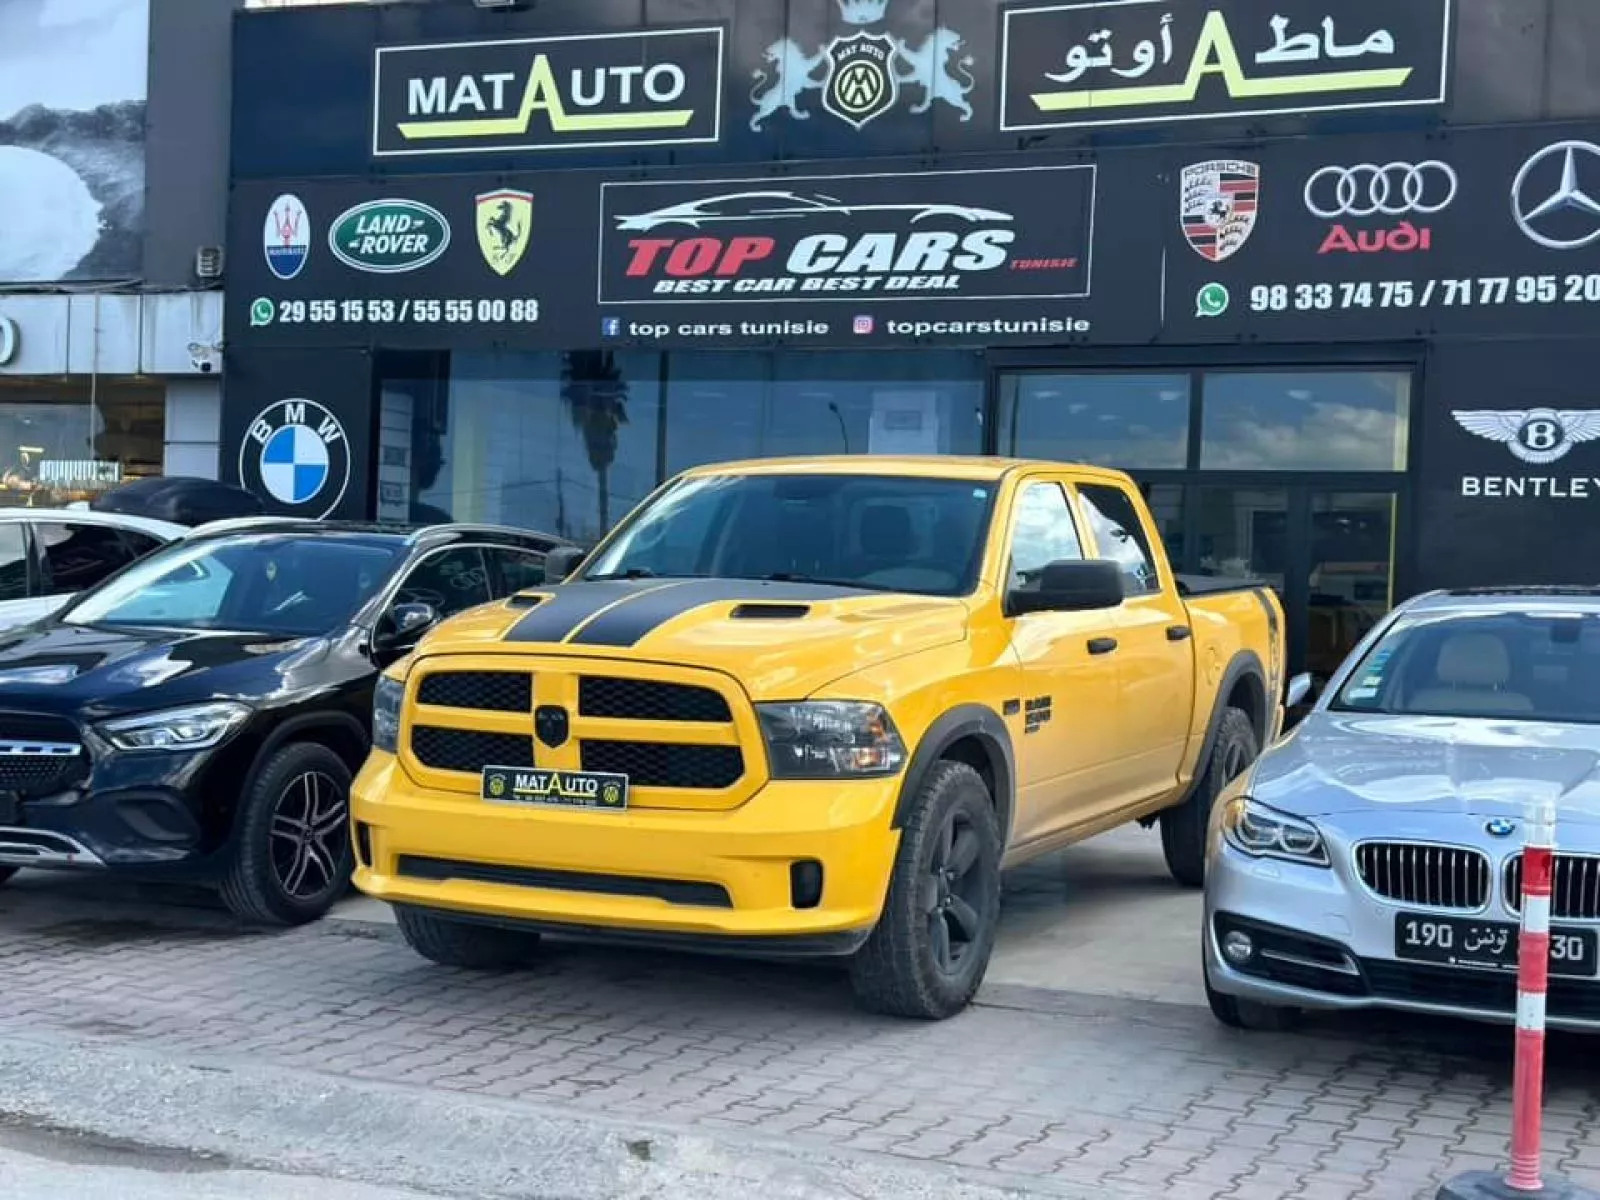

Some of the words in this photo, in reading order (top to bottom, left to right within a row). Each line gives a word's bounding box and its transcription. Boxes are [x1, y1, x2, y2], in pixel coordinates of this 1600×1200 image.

[1255, 13, 1396, 63] ماط
[626, 236, 776, 277] TOP
[786, 229, 1016, 274] CARS
[652, 279, 731, 293] BEST
[733, 278, 796, 291] CAR
[800, 276, 882, 290] BEST
[884, 274, 960, 290] DEAL
[1251, 285, 1288, 310] 98
[1295, 284, 1332, 309] 33
[1340, 283, 1373, 308] 74
[1379, 280, 1414, 307] 75
[1420, 280, 1436, 307] /
[1442, 279, 1472, 305] 71
[1478, 278, 1510, 304] 77
[1516, 276, 1557, 302] 95
[1564, 274, 1600, 302] 20
[279, 300, 305, 322] 29
[309, 300, 336, 322] 55
[340, 299, 362, 322] 15
[368, 300, 394, 322] 53
[399, 300, 410, 322] /
[413, 300, 441, 322] 55
[445, 300, 473, 322] 55
[477, 300, 506, 322] 00
[510, 300, 539, 322] 88
[629, 322, 670, 338] top
[677, 322, 732, 335] cars
[741, 319, 829, 335] tunisie
[887, 316, 1090, 336] topcarstunisie
[251, 402, 341, 445] BMW
[1405, 921, 1453, 948] 190
